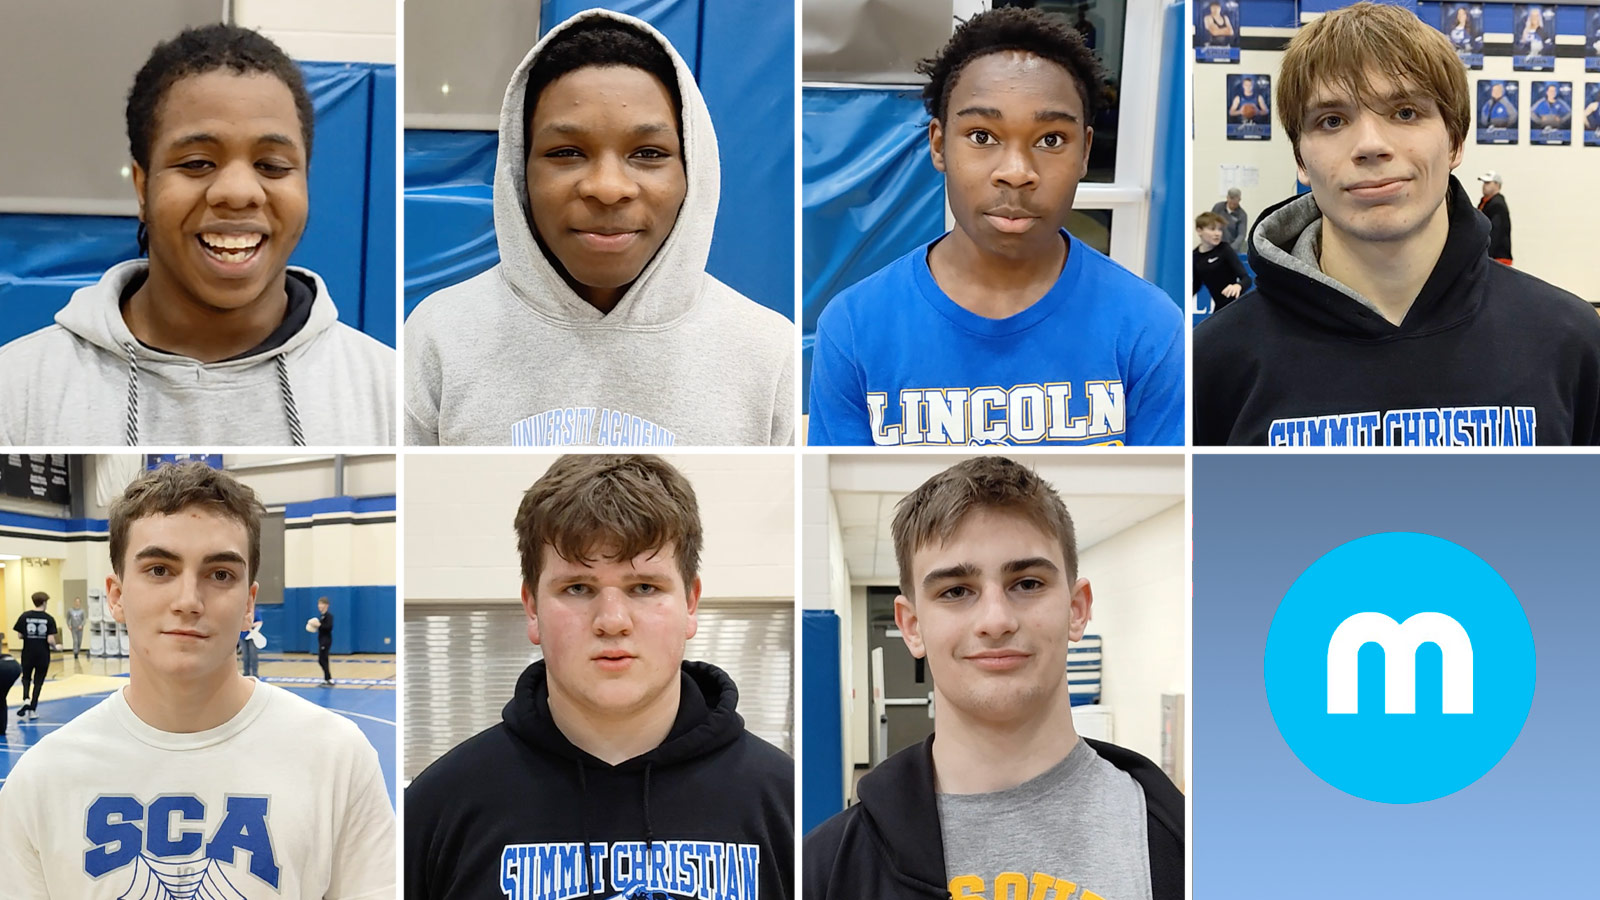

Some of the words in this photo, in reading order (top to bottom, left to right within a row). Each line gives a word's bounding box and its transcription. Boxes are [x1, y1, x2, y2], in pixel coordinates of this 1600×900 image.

[511, 407, 596, 446] UNIVERSITY
[867, 380, 1126, 446] LINCOLN
[1383, 406, 1537, 446] CHRISTIAN
[82, 792, 284, 895] SCA
[500, 842, 609, 900] SUMMIT
[610, 841, 760, 900] CHRISTIAN
[949, 871, 1107, 900] SOU
